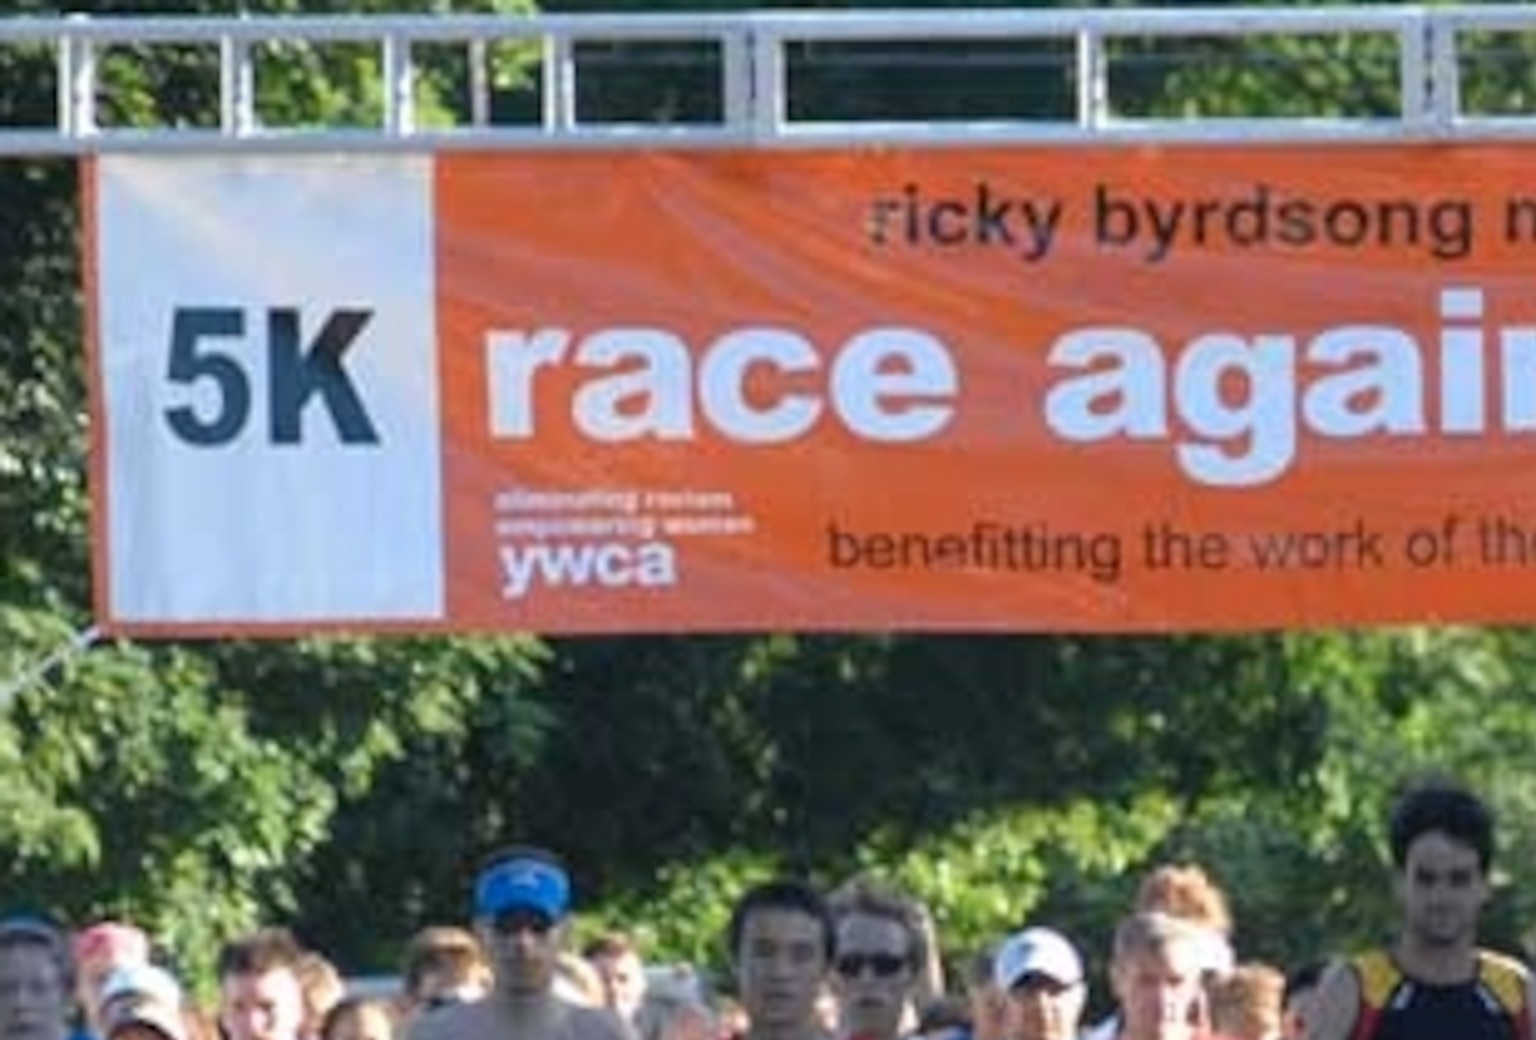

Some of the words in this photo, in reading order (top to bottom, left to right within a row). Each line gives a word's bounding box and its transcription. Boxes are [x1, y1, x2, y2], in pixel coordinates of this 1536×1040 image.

[868, 182, 1061, 262] ricky
[1094, 181, 1473, 262] byrdsong
[162, 305, 381, 448] 5K
[484, 325, 959, 445] race
[499, 540, 677, 600] ywca
[828, 521, 1121, 583] benefitting
[1143, 521, 1230, 571] the
[1249, 518, 1385, 570] work
[1406, 514, 1457, 568] of
